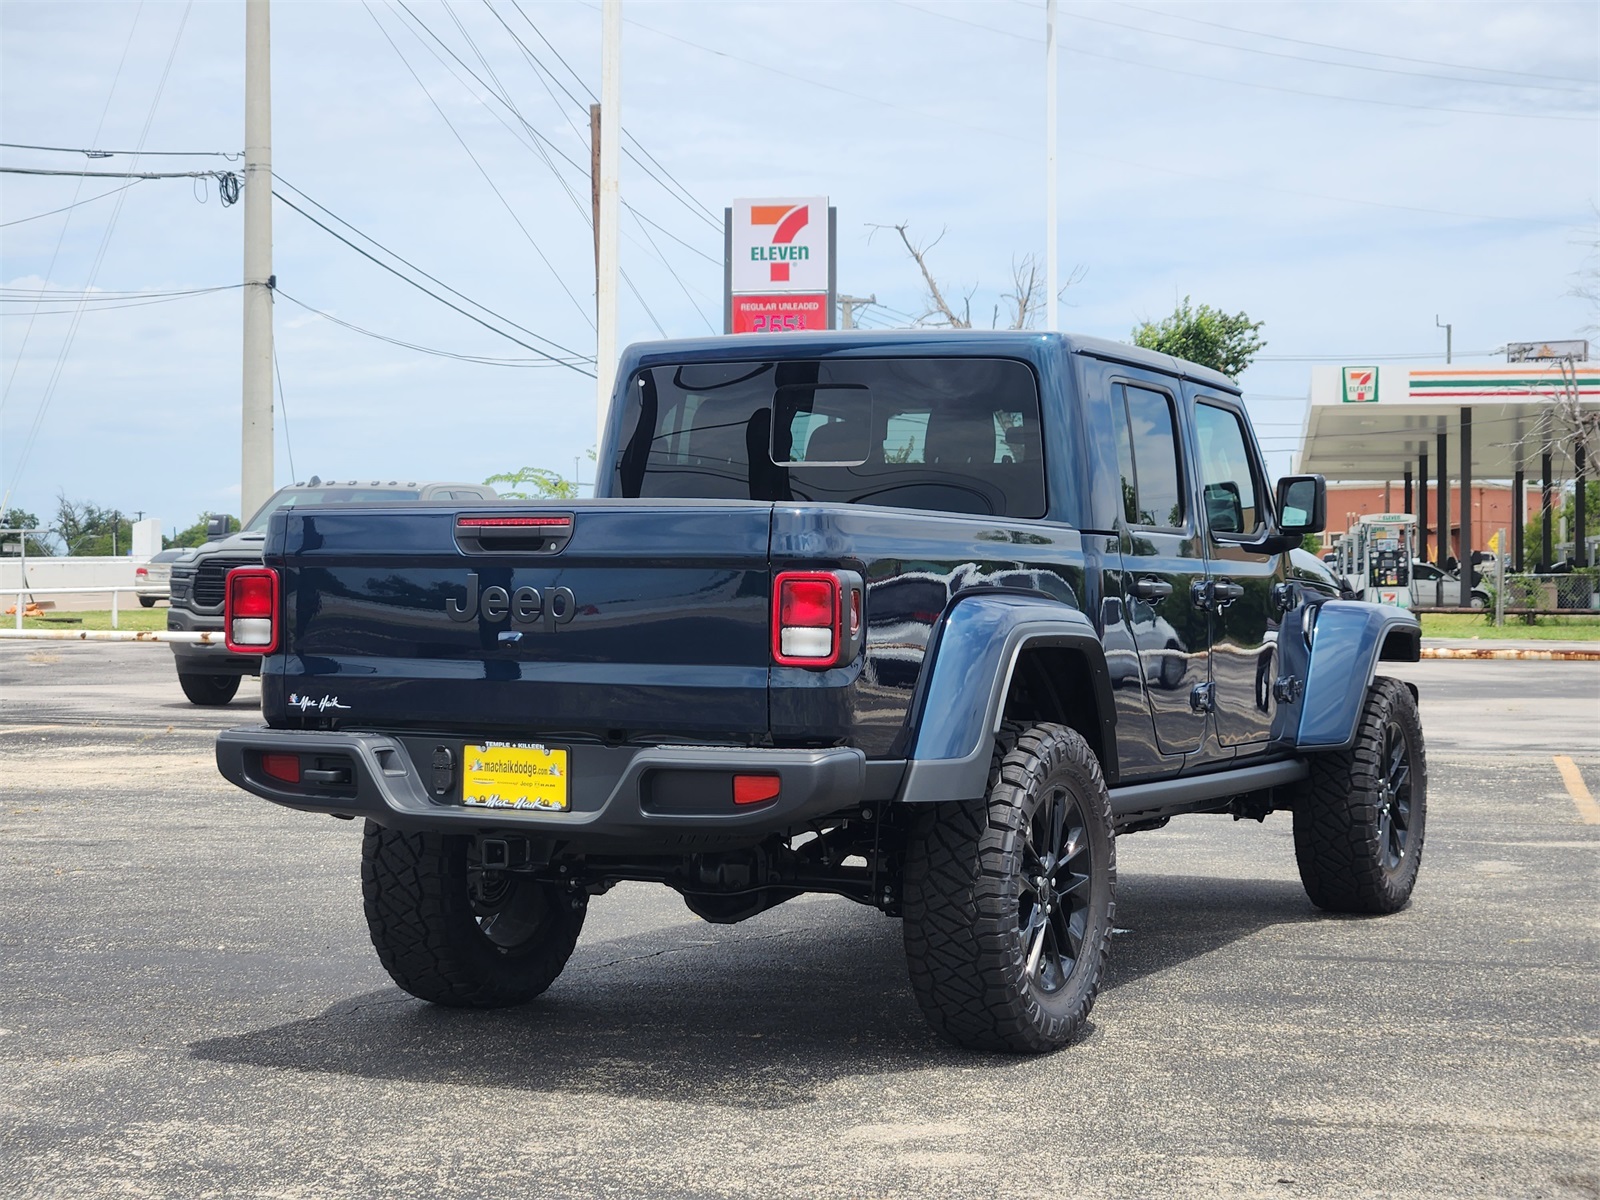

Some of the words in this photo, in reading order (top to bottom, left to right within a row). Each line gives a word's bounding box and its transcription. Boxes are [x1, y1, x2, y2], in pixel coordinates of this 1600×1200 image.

[740, 302, 777, 311] REGULAR
[778, 302, 819, 311] UNLEADED
[446, 573, 577, 633] Jeep
[300, 695, 318, 712] Mac
[319, 694, 344, 712] Haik
[517, 742, 545, 750] KILLEEN
[484, 760, 549, 777] machaikdodge.com
[486, 793, 512, 808] Mac
[513, 796, 546, 810] Haik
